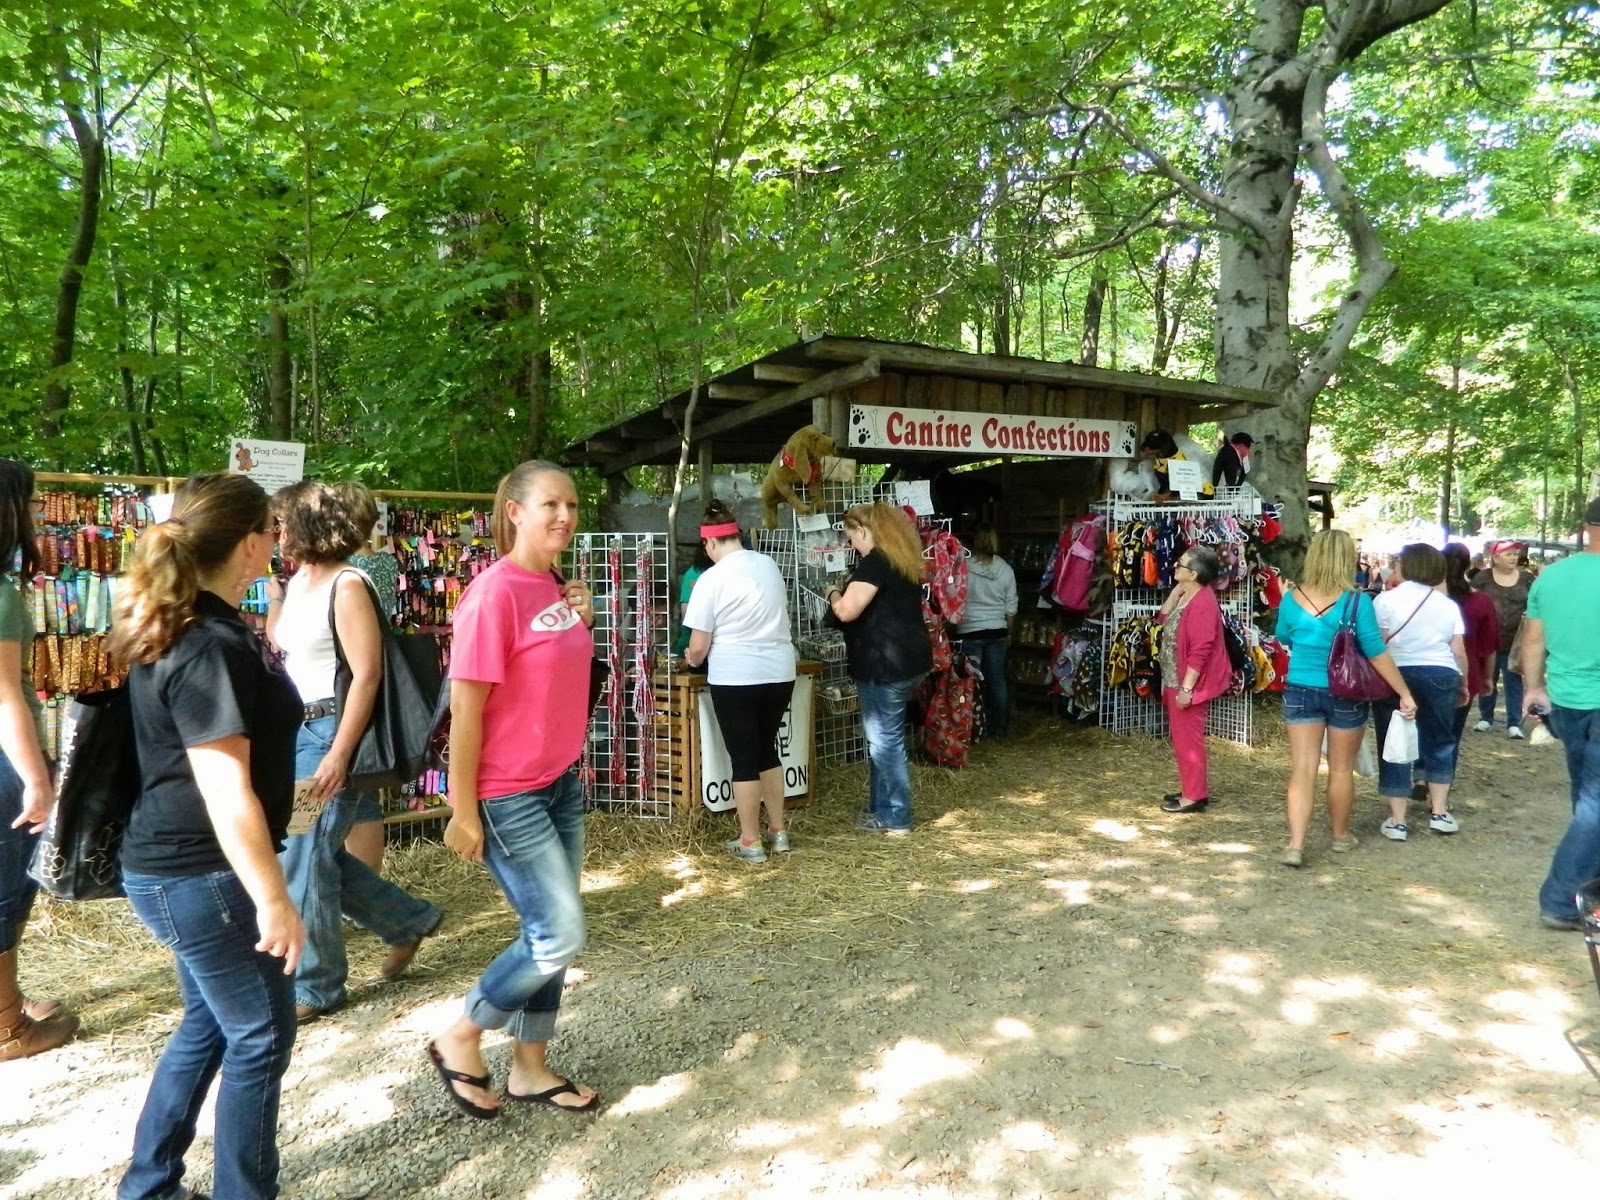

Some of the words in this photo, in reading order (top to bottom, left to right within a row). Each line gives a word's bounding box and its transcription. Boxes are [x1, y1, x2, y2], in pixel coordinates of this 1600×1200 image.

[886, 411, 972, 448] Canine
[982, 417, 1111, 454] Confections
[253, 446, 271, 457] Dog
[271, 448, 298, 457] Collars
